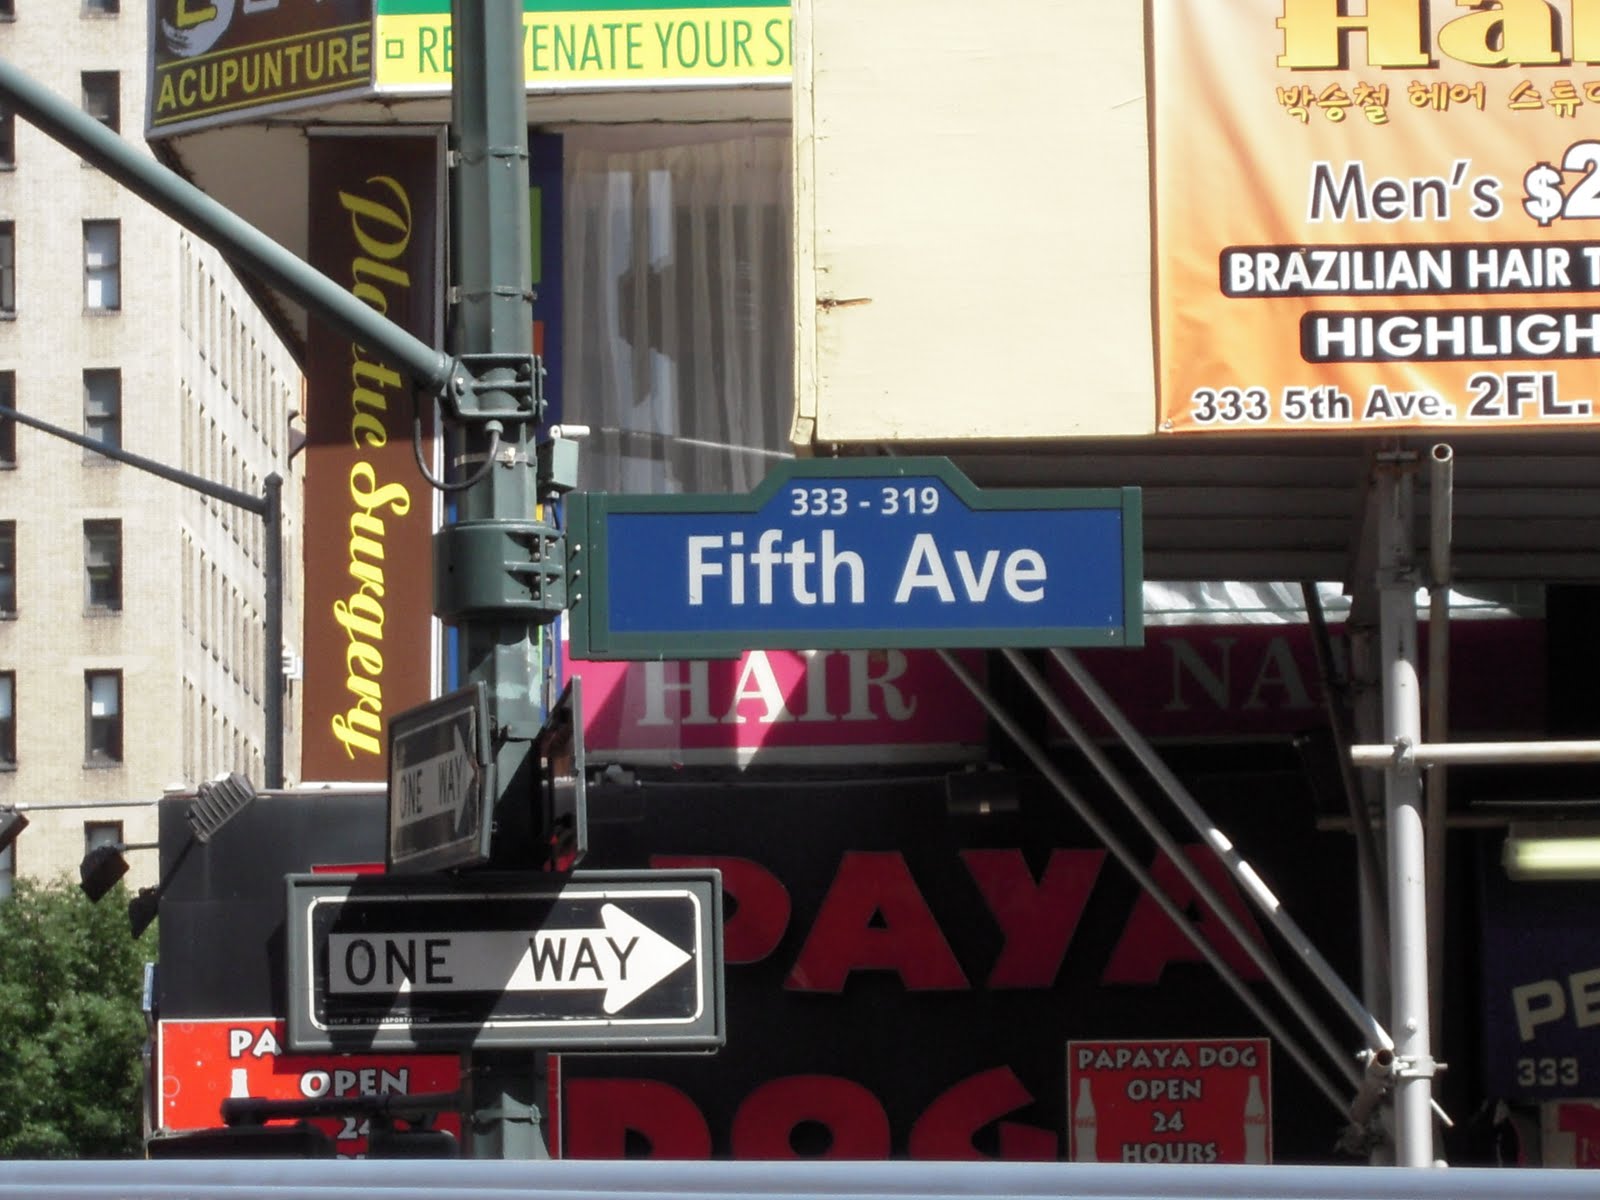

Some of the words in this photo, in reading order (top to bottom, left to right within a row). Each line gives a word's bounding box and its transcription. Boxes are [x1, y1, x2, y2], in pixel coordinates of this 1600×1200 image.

[418, 20, 646, 74] REENATE
[655, 18, 754, 69] YOUR
[156, 31, 370, 111] ACUPUNTURE
[1276, 80, 1390, 124] 박승철
[1407, 80, 1486, 112] 헤어
[1308, 159, 1502, 222] Men's
[1229, 250, 1452, 292] BRAZILIAN
[1467, 248, 1572, 288] HAIR
[338, 175, 412, 450] Platic
[1192, 386, 1269, 423] 333
[1281, 385, 1352, 421] 5th
[1364, 386, 1458, 421] Ave.
[1468, 371, 1593, 418] 2FL.
[790, 488, 848, 516] 333
[881, 487, 940, 515] 319
[688, 529, 866, 606] Fifth
[895, 532, 1048, 604] Ave
[332, 461, 410, 760] Surgery
[636, 649, 918, 725] HAIR
[1161, 635, 1352, 712] NA
[400, 769, 423, 820] ONE
[438, 754, 464, 807] WAY
[650, 848, 1281, 993] PAYA
[344, 938, 454, 985] ONE
[529, 936, 640, 983] WAY
[366, 1016, 431, 1024] TRANSPORTATION
[1078, 1047, 1192, 1070] PAPAYA
[1199, 1045, 1257, 1068] DOG
[1516, 1056, 1579, 1087] 333
[300, 1068, 408, 1099] OPEN
[1127, 1079, 1202, 1101] OPEN
[1152, 1111, 1185, 1133] 24
[1121, 1142, 1218, 1163] HOURS
